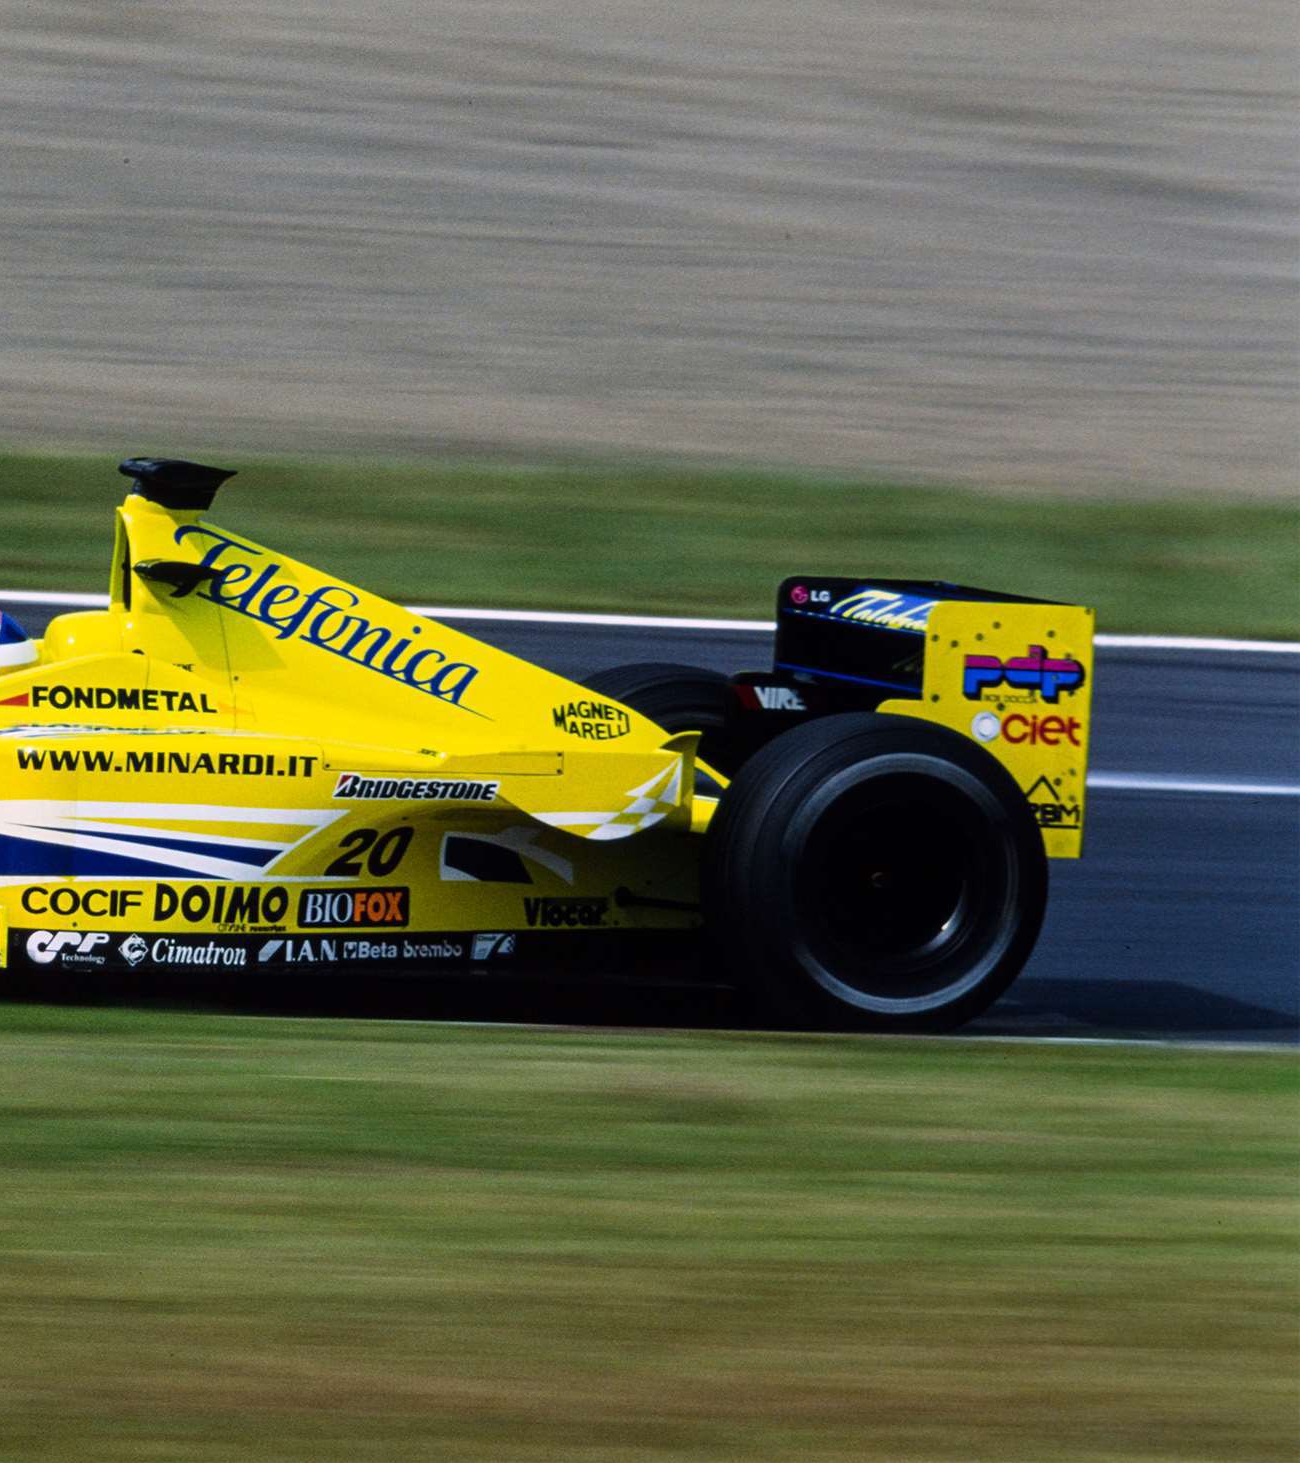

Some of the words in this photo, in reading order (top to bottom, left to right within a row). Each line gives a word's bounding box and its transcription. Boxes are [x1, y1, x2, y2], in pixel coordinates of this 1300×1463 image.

[810, 591, 830, 602] LG
[32, 685, 218, 713] FONDMETAL
[17, 748, 318, 777] WWW.MINARDI.IT
[334, 775, 498, 800] BRIDGESTONE
[324, 827, 414, 877] 20
[22, 887, 143, 917] COCIF
[153, 883, 289, 923] DOIMO
[304, 892, 403, 923] BIOFOX
[61, 952, 106, 964] Technology
[152, 937, 247, 966] Cimatron
[285, 939, 338, 962] I.A.N.
[358, 941, 397, 959] Beta
[403, 940, 462, 958] brembo
